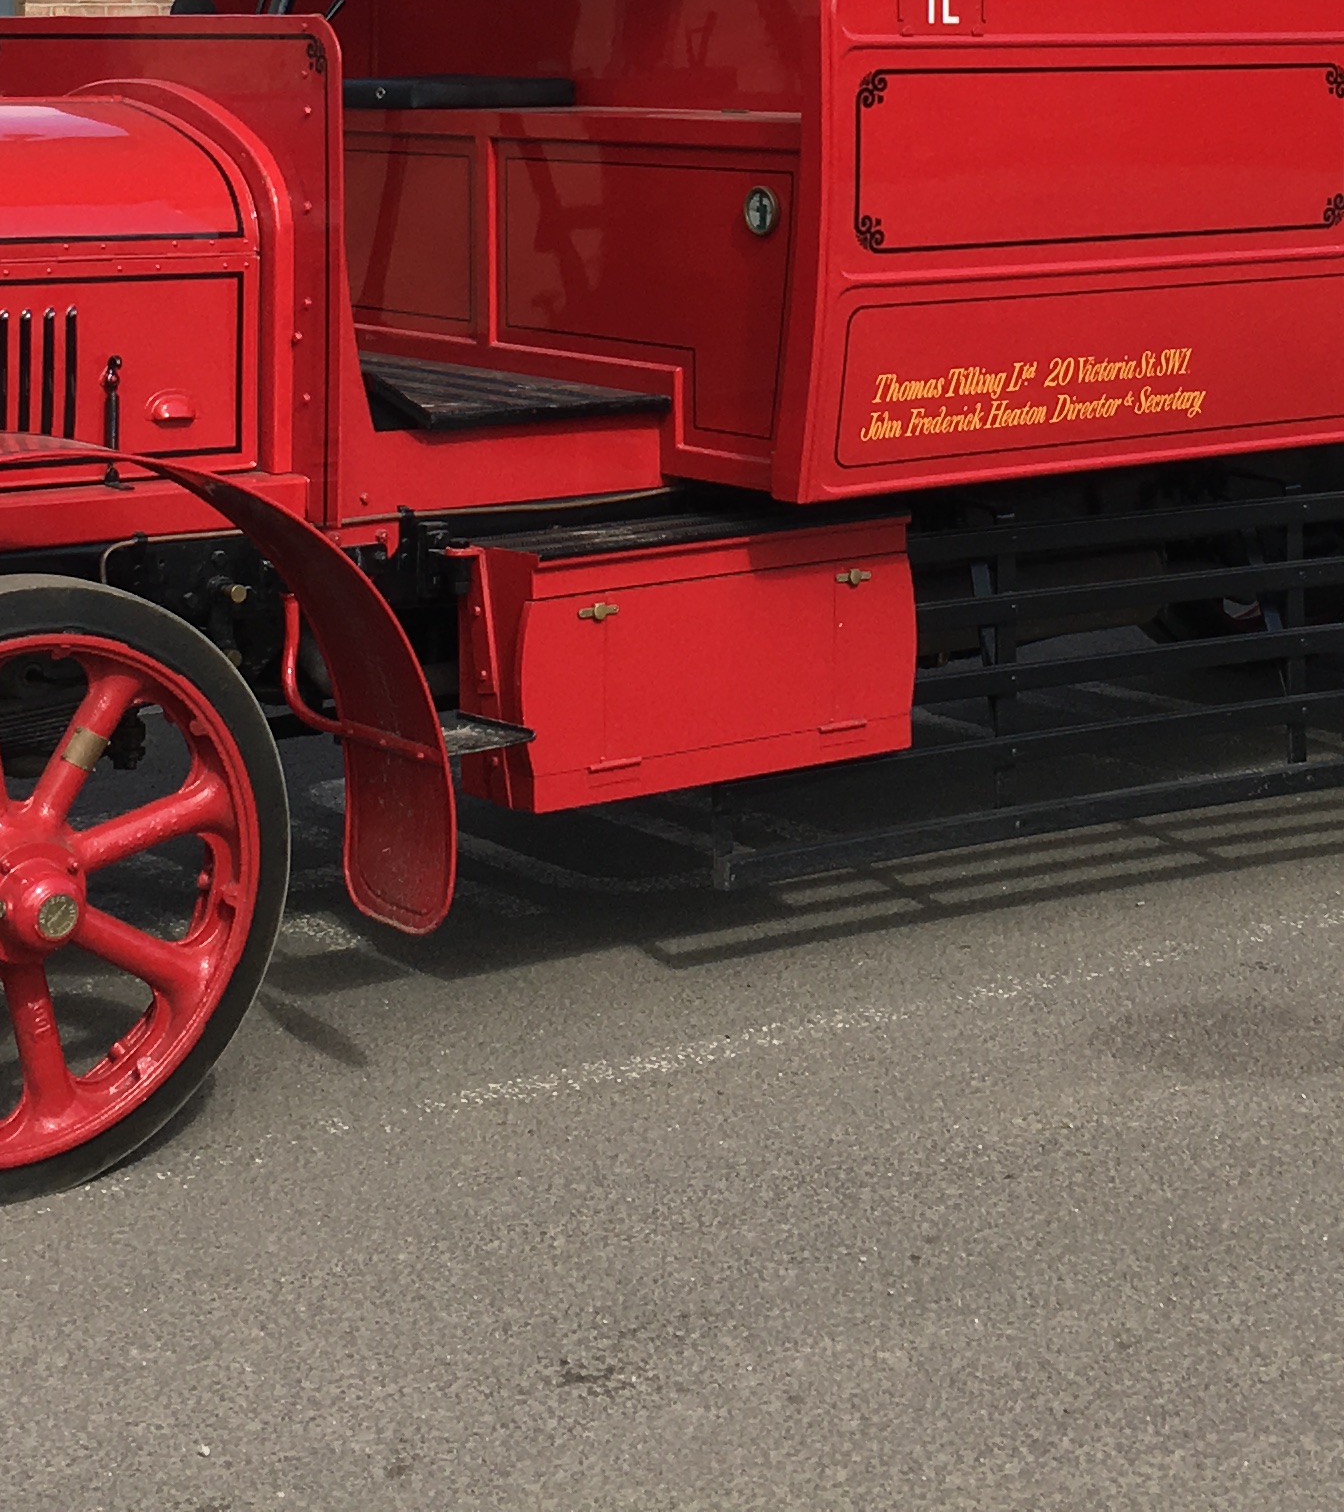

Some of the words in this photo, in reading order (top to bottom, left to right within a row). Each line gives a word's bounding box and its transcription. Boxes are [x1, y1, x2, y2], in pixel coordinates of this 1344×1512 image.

[872, 372, 944, 404] Thomas
[945, 365, 1008, 398] Tilling
[1043, 357, 1075, 388] 20
[1076, 355, 1136, 384] Victoria
[860, 410, 904, 442] John
[904, 402, 985, 438] Frederick
[983, 399, 1047, 430] Heaton
[1049, 393, 1122, 425] Director
[1134, 385, 1207, 419] Secretary
